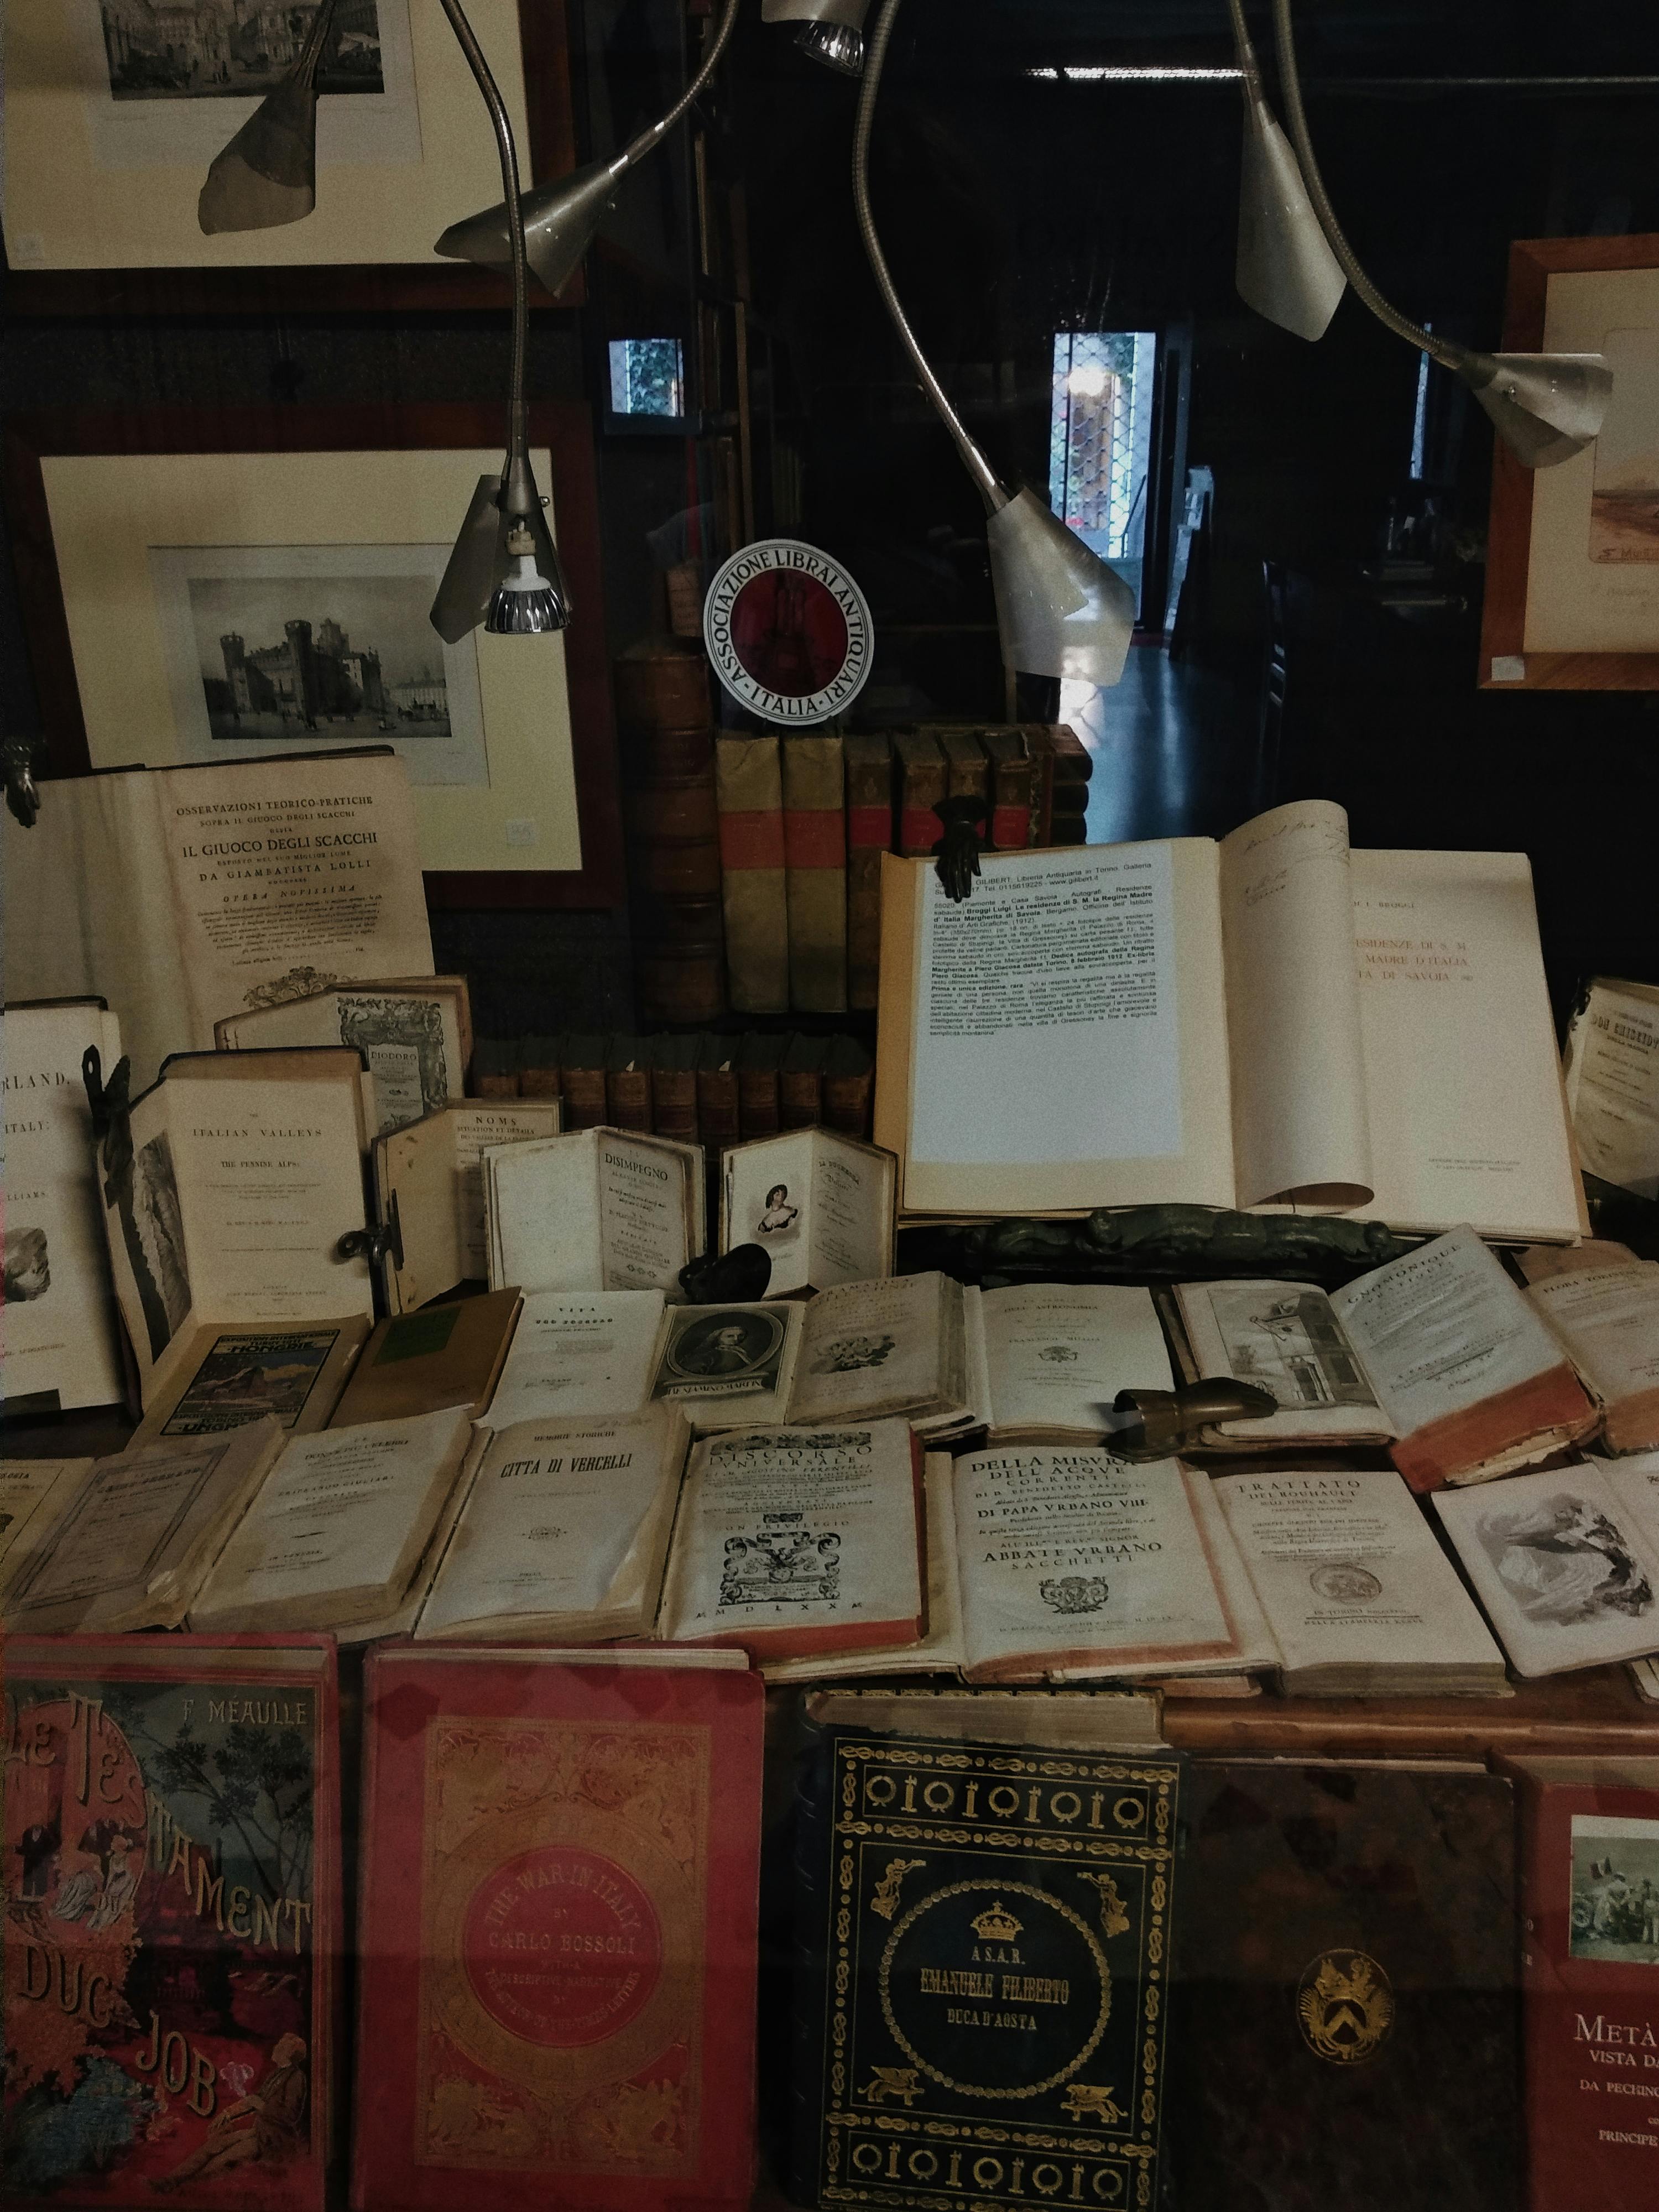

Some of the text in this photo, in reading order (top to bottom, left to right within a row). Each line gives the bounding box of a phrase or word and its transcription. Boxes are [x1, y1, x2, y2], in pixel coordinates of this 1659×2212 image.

[713, 549, 864, 705] ASSOCIAZIONE LIBRAI ANTIQUARI
[750, 686, 818, 715] ITALIA
[176, 802, 261, 816] OSSERVAZIONI
[317, 811, 355, 819] SCACCHI
[183, 832, 377, 858] IL GIUOCO DEGLI SCACCHI
[200, 873, 218, 881] DA
[330, 860, 370, 870] LOLLI
[1366, 955, 1408, 964] MADRE
[371, 1051, 418, 1061] DIODORO
[476, 1116, 517, 1126] NOMS
[192, 1129, 322, 1138] ITALIAN VALLEYS
[605, 1153, 668, 1181] DISIMPEGNO
[547, 1458, 563, 1473] DI
[570, 1453, 633, 1473] VERCELLI
[710, 1446, 872, 1465] DISCORSO
[972, 1457, 1043, 1472] DELLA
[1238, 1480, 1360, 1493] TRATTATO
[1002, 1505, 1039, 1515] PAPA
[1044, 1500, 1113, 1511] VRBANO
[983, 1542, 1162, 1562] ABBATE VRBANO
[1011, 1554, 1133, 1570] SACCHETTI
[208, 1695, 307, 1725] MÉAULLE
[484, 1887, 520, 1926] THE
[517, 1865, 563, 1890] WAR
[592, 1875, 643, 1929] ITALY
[489, 1932, 636, 1955] CARLO BOSSOLI
[17, 1945, 112, 2029] DUC
[920, 1967, 1070, 2005] EMANUELE FILIBERTO
[947, 2007, 1037, 2031] DUCA D'AOSTA
[1573, 2013, 1657, 2047] METÀ
[135, 2008, 217, 2117] JOB
[1589, 2048, 1637, 2067] VISTA
[1580, 2079, 1600, 2091] DA
[1599, 2129, 1658, 2147] PRINCIPE
